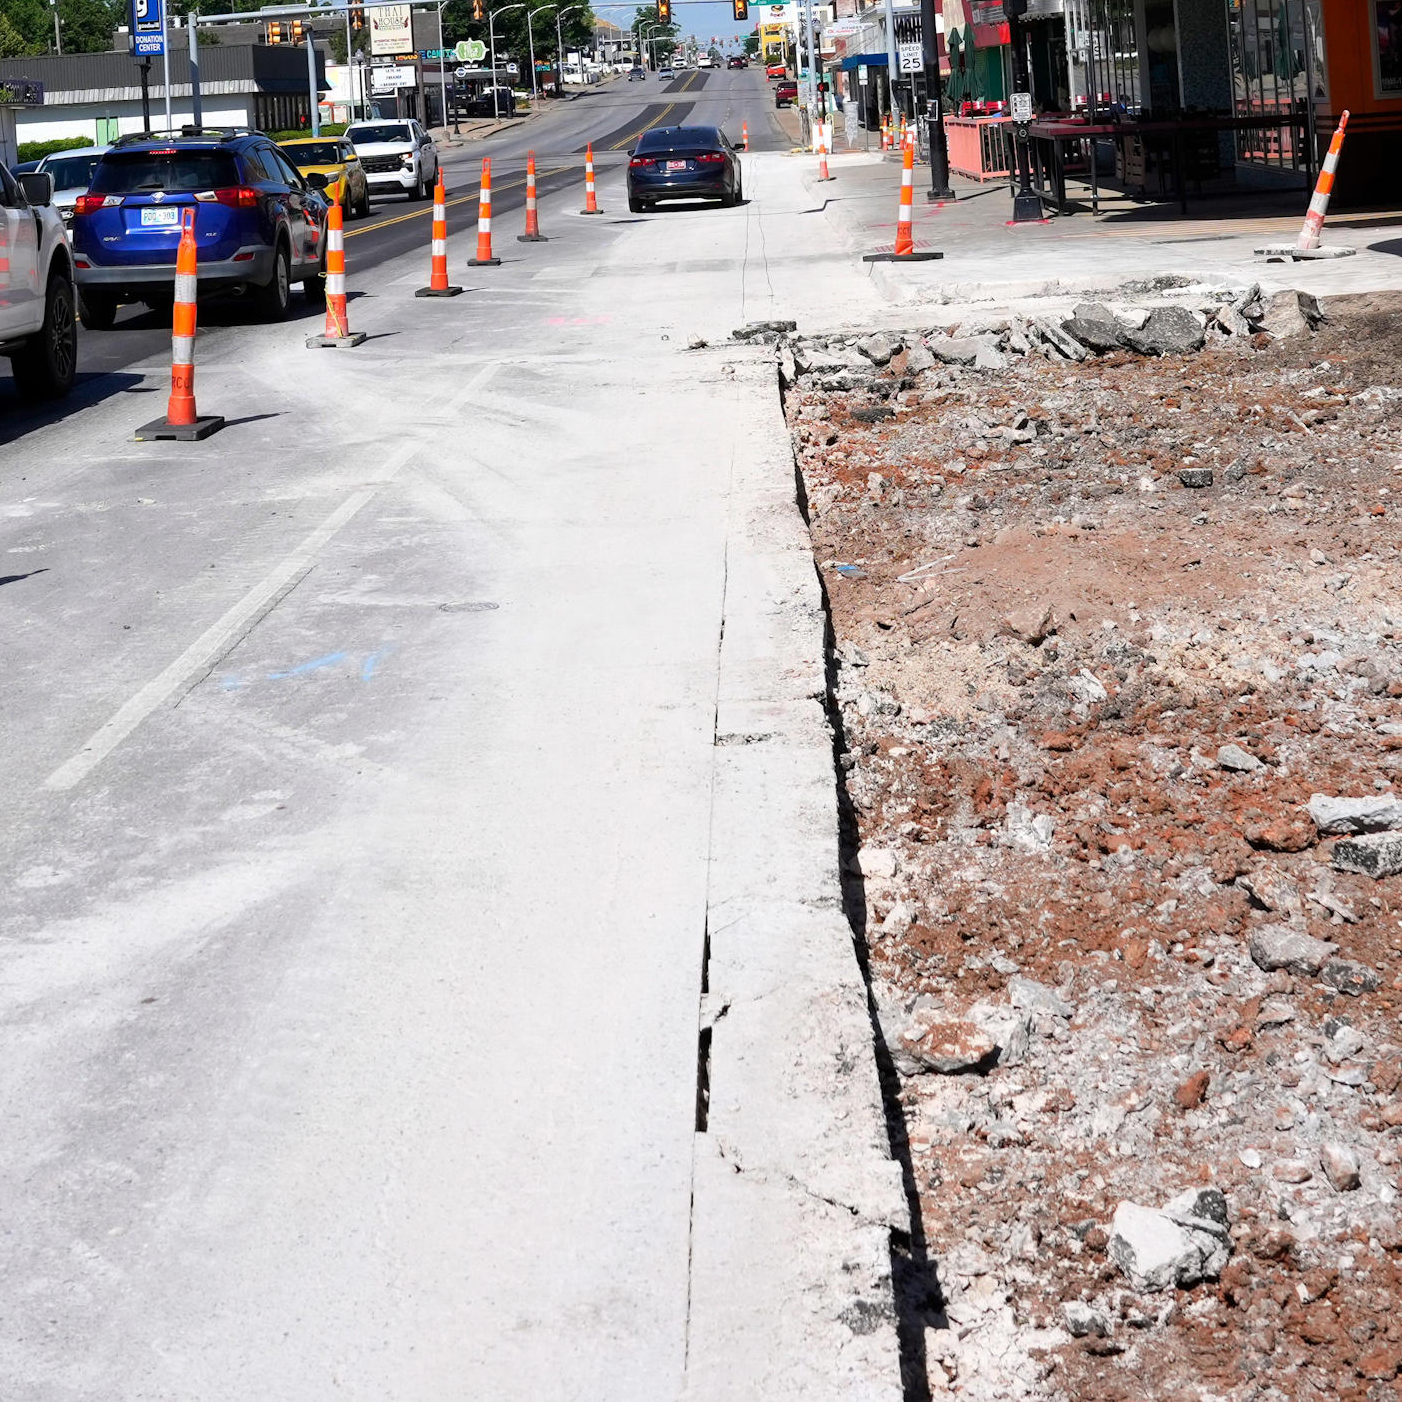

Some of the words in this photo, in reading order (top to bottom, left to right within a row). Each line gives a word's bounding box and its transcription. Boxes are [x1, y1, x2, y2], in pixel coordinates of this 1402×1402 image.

[378, 6, 403, 18] THAI
[378, 16, 405, 26] HOUSE
[135, 35, 164, 44] DONATION
[138, 44, 161, 52] CENTER
[902, 58, 921, 69] 25
